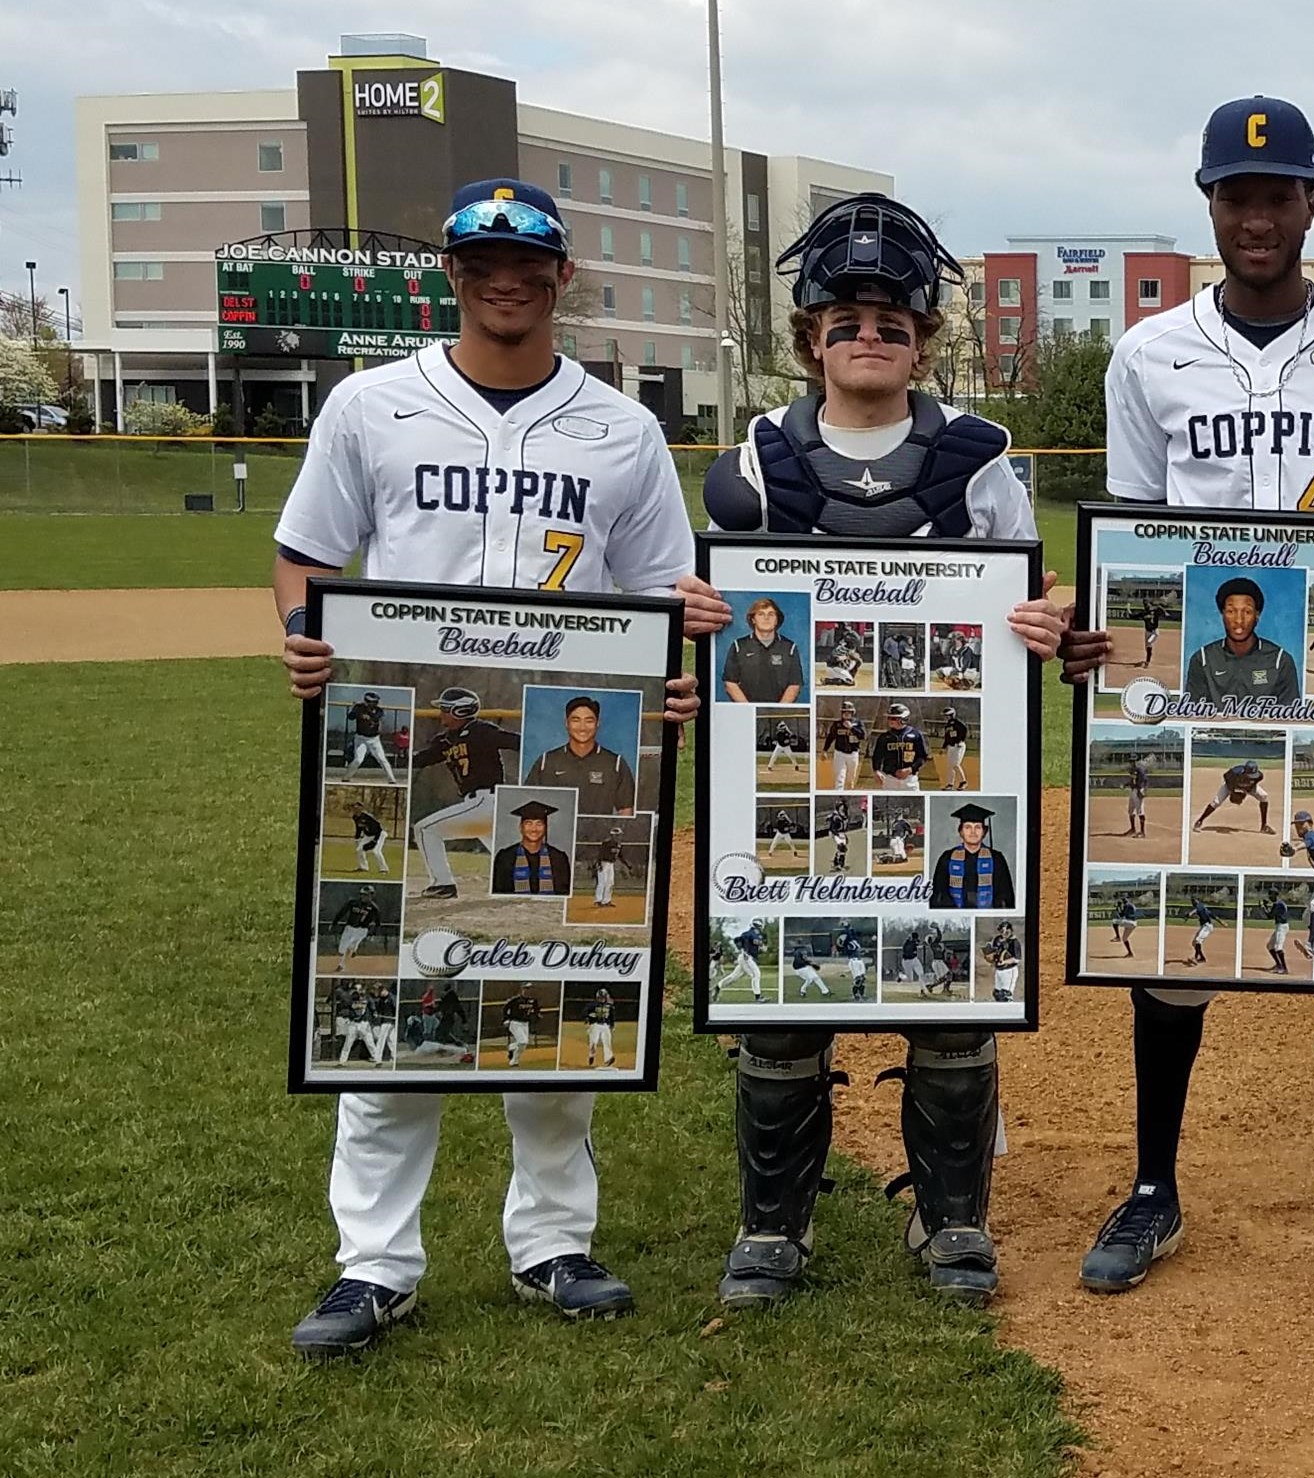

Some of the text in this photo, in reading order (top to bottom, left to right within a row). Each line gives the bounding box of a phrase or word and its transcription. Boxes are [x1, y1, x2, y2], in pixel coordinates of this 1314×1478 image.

[355, 80, 441, 118] HOME 2
[1246, 112, 1267, 149] C
[217, 243, 446, 268] JOE CANNON STADI
[1056, 246, 1106, 259] FAIRFIELD
[222, 262, 254, 272] AT BAT
[292, 265, 316, 275] BALL
[342, 267, 375, 278] STRIKE
[404, 270, 423, 280] OUT
[280, 290, 286, 299] 2
[292, 291, 298, 299] 3
[310, 292, 316, 300] 4
[322, 292, 328, 300] 5
[353, 294, 359, 302] 7
[410, 296, 431, 305] RUNS
[440, 297, 457, 306] HITS
[221, 340, 246, 349] 1990
[337, 346, 408, 356] RECREATION
[338, 332, 388, 346] ANNE
[414, 463, 591, 524] COPPIN
[1134, 523, 1197, 540] COPPIN
[1200, 525, 1250, 543] STATE
[538, 529, 585, 592] 7
[1192, 541, 1299, 568] Baseball
[754, 558, 986, 579] COPPIN STATE UNIVERSITY
[813, 578, 927, 606] Baseball
[371, 602, 632, 634] COPPIN STATE UNIVERSITY
[437, 626, 565, 661] Baseball
[1144, 692, 1216, 718] Delvin
[723, 874, 935, 903] Brett Helmbrecht
[443, 938, 643, 977] Caleb Duhay
